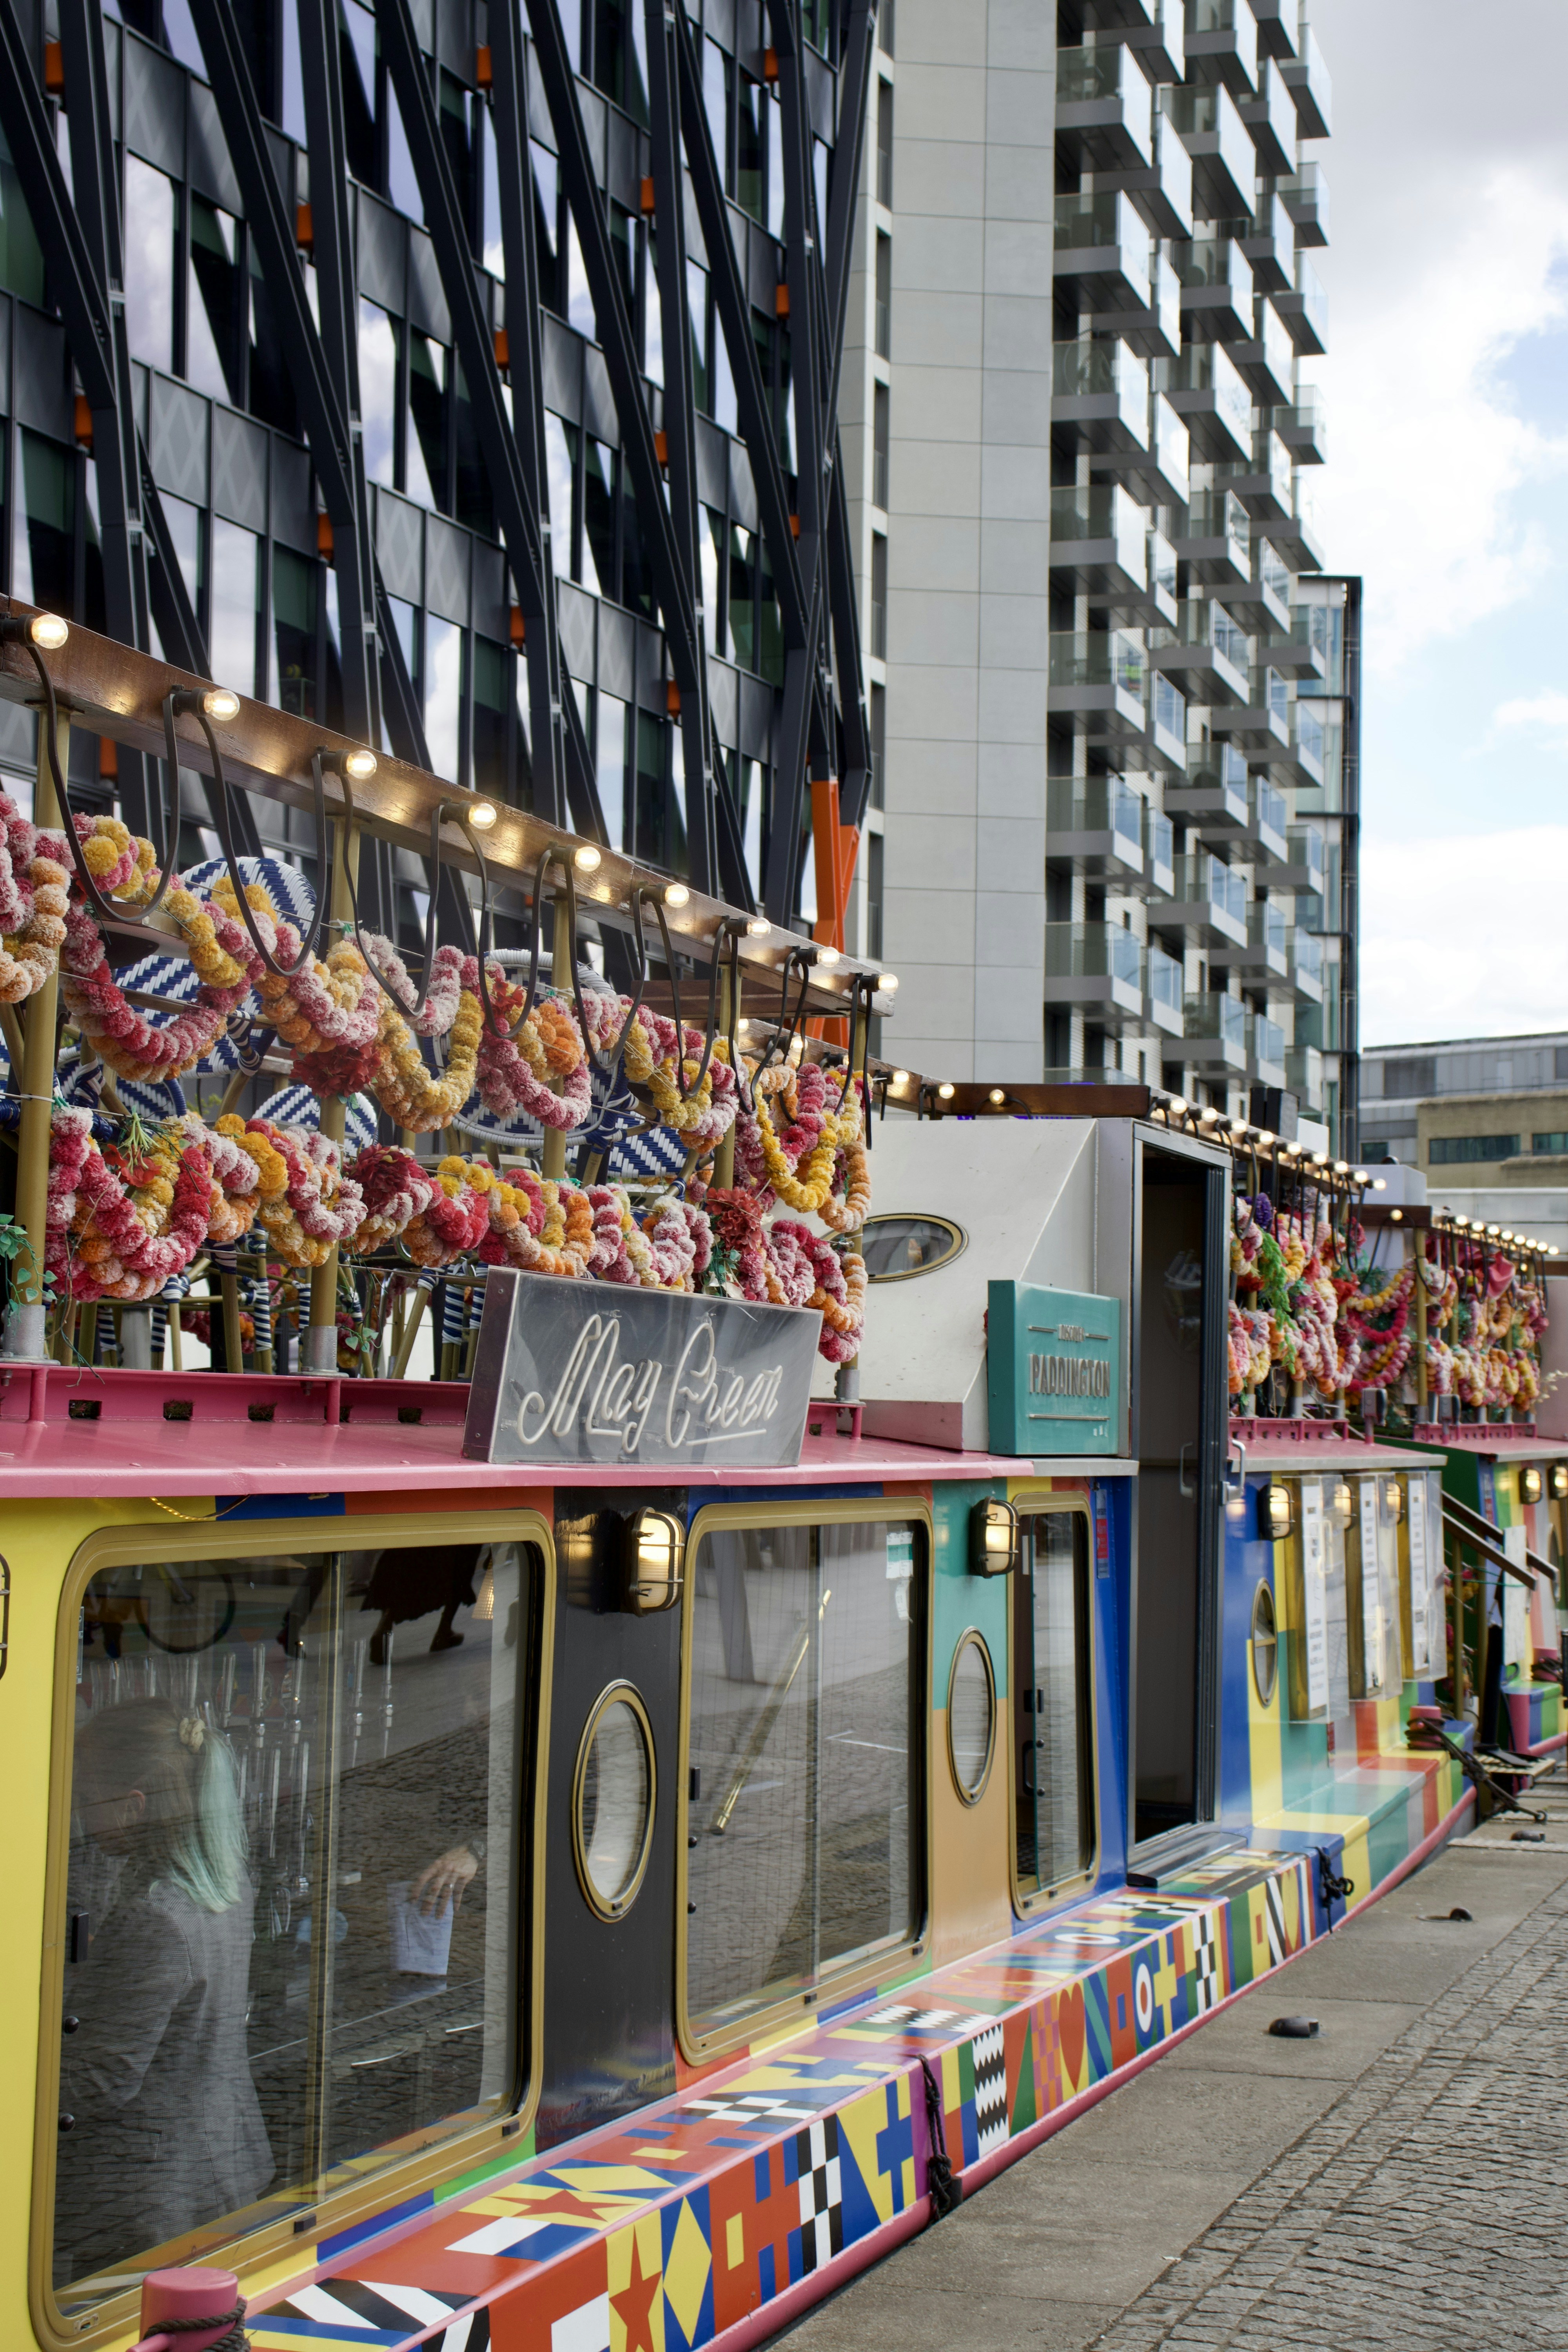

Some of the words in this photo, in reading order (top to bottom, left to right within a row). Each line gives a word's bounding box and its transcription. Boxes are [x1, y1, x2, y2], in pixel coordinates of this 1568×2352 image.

[1058, 1324, 1085, 1342] DISCOVER
[517, 1313, 662, 1453] May
[666, 1323, 783, 1448] Green
[1029, 1354, 1110, 1397] PADDINGTON
